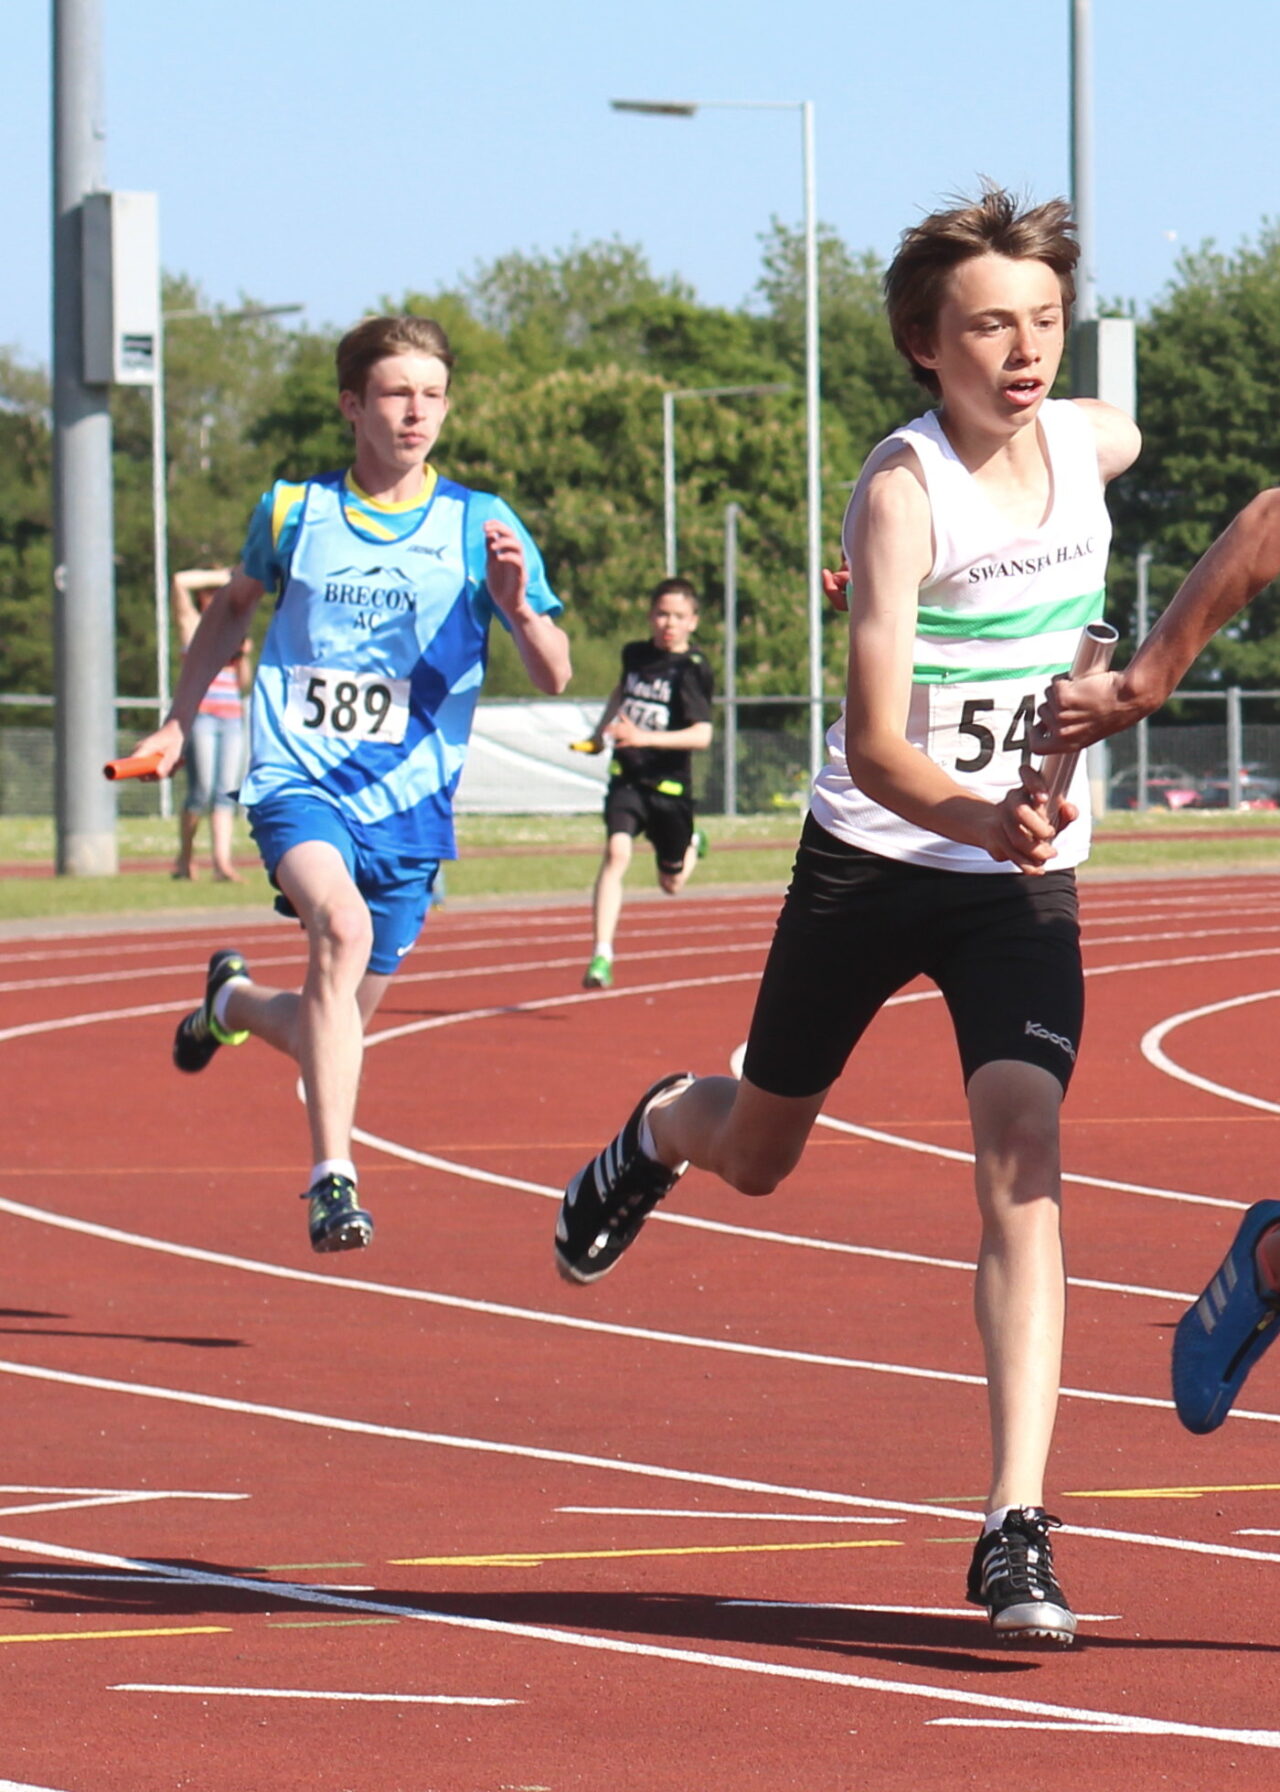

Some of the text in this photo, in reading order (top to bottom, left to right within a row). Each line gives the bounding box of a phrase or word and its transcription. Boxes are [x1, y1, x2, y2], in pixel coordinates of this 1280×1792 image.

[968, 553, 1052, 584] SWANSEA
[324, 583, 417, 612] BRECON
[352, 611, 382, 633] AC
[302, 677, 391, 734] 589
